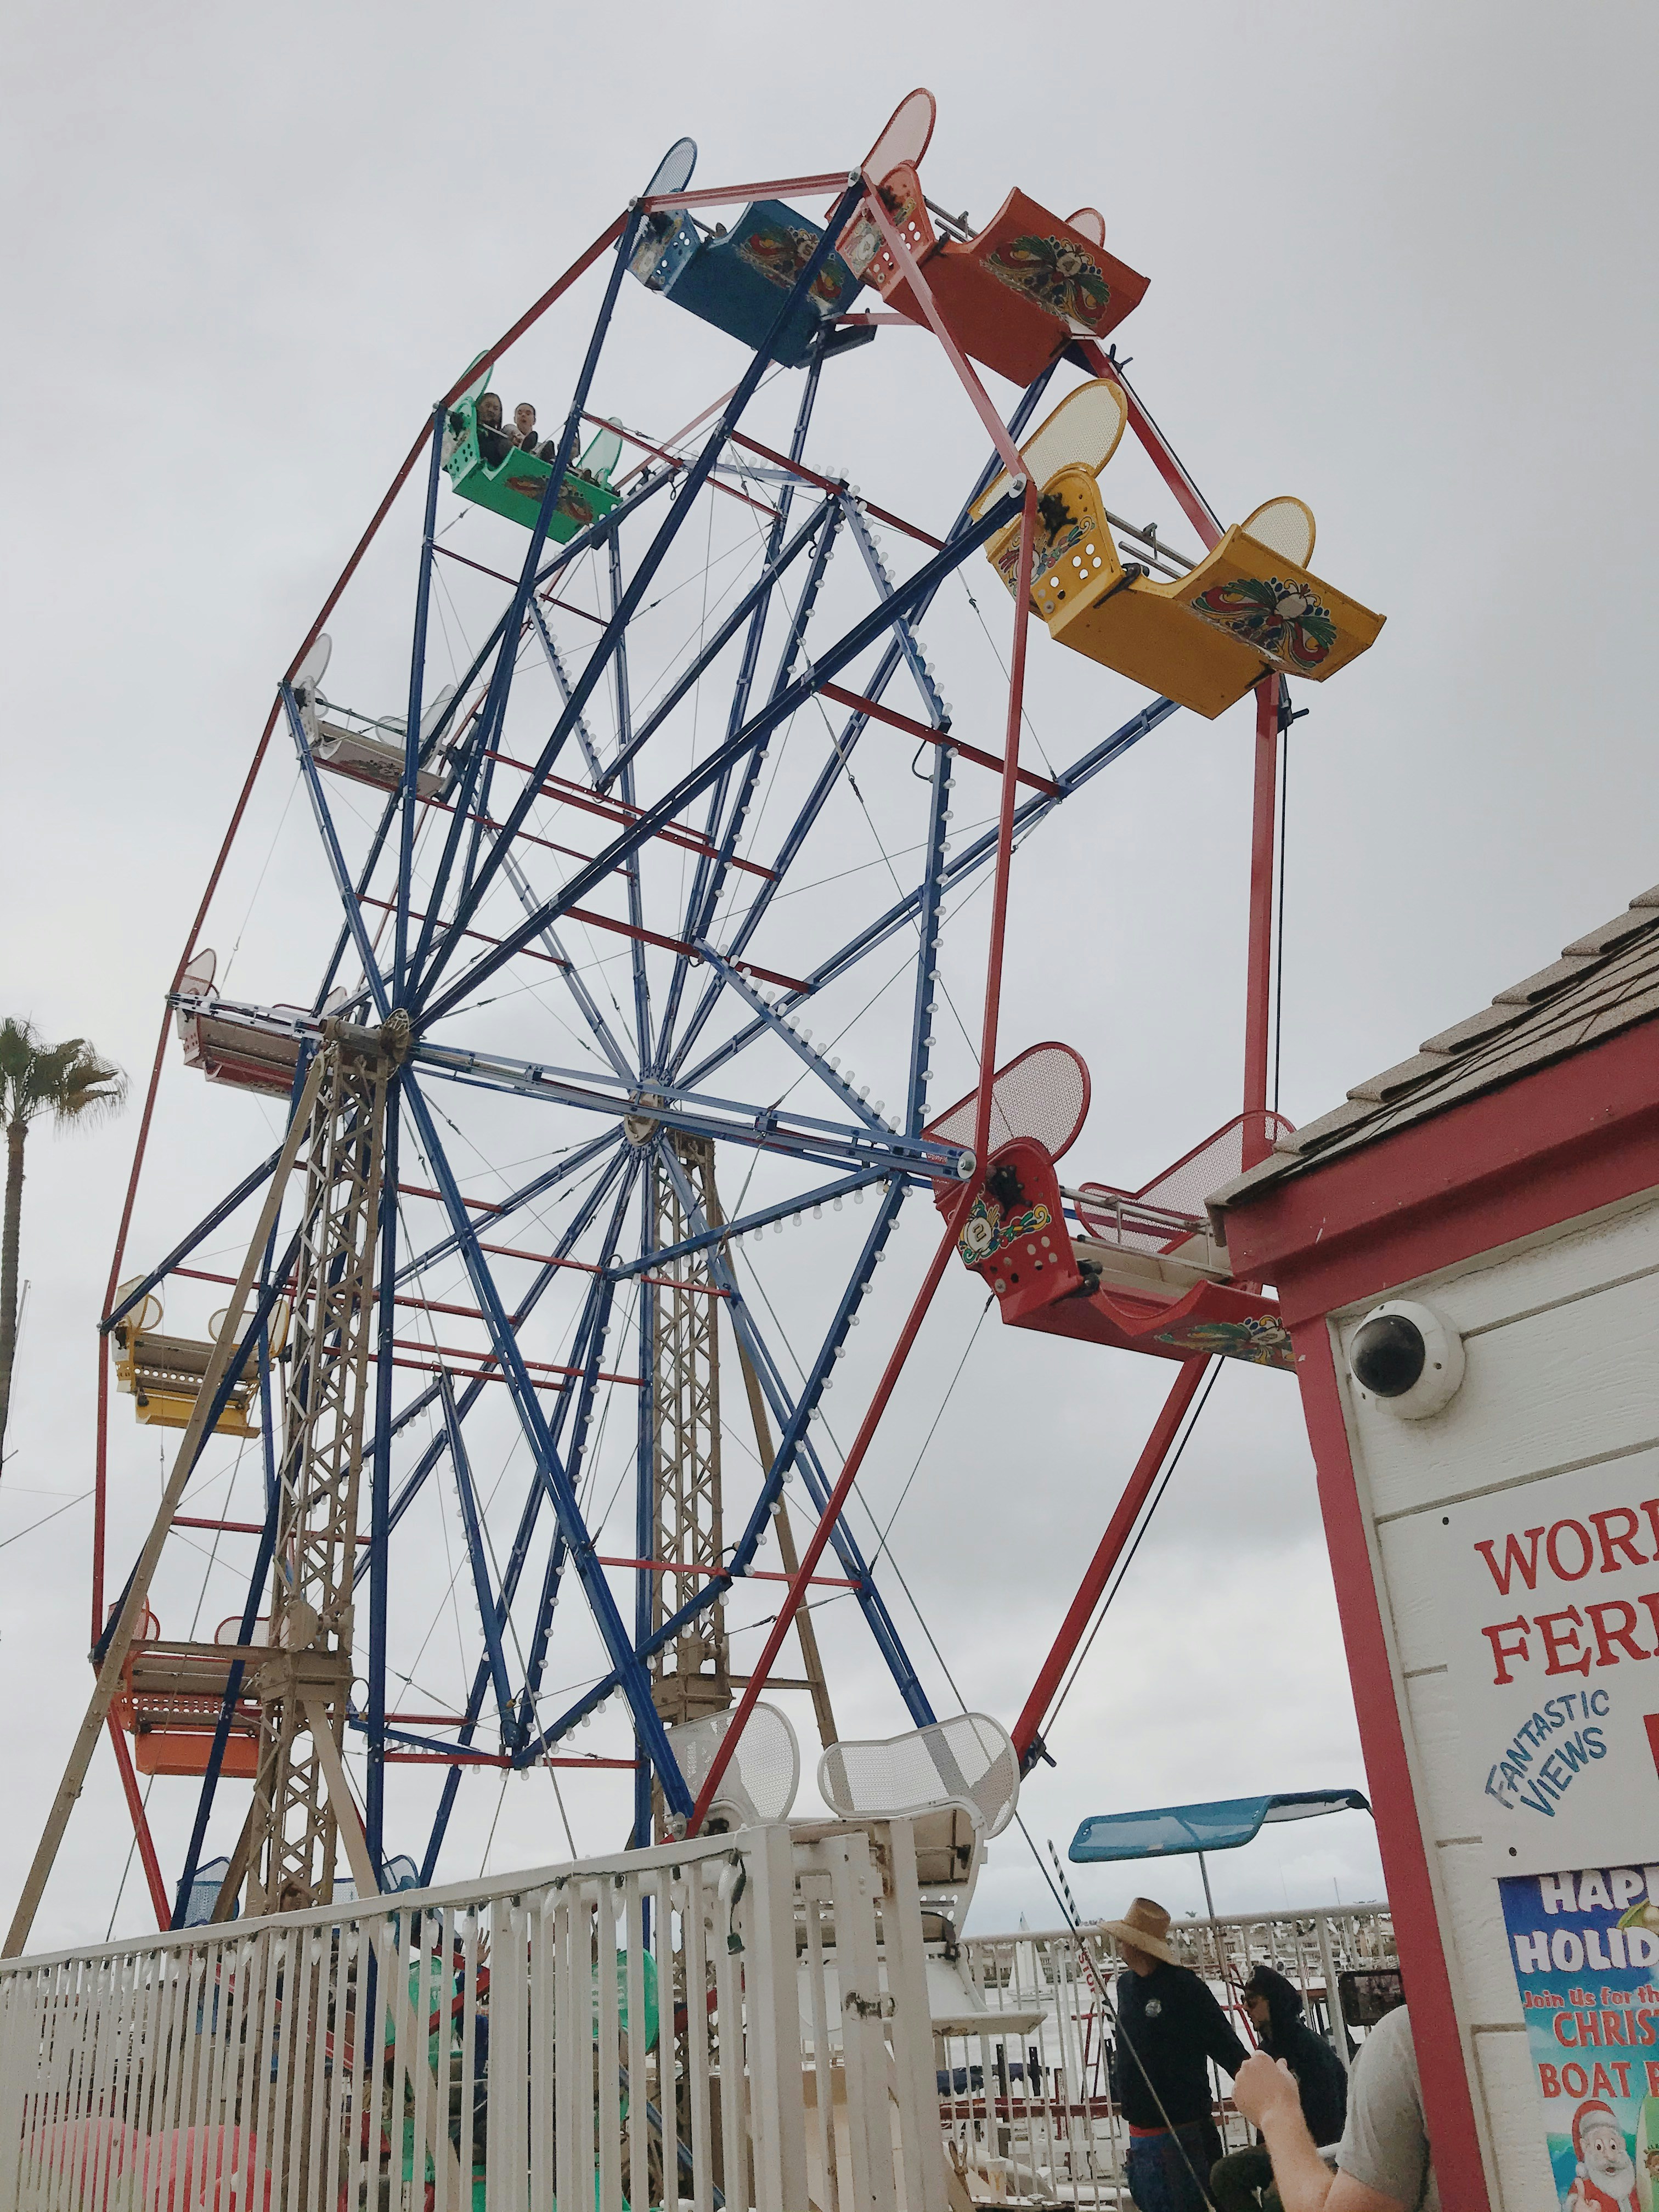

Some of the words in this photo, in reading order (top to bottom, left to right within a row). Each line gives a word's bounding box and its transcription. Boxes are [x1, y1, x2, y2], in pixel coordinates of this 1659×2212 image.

[973, 1223, 987, 1243] 2
[1485, 1689, 1610, 1810] FANTASTIC
[1520, 1727, 1607, 1817] VIEWS
[1513, 1926, 1659, 1974] HOLID
[1525, 1990, 1565, 2008] Join
[1570, 1988, 1596, 2007] Us
[1601, 1987, 1632, 2006] for
[1553, 2008, 1659, 2047] CHRIS
[1538, 2062, 1631, 2098] BOAT
